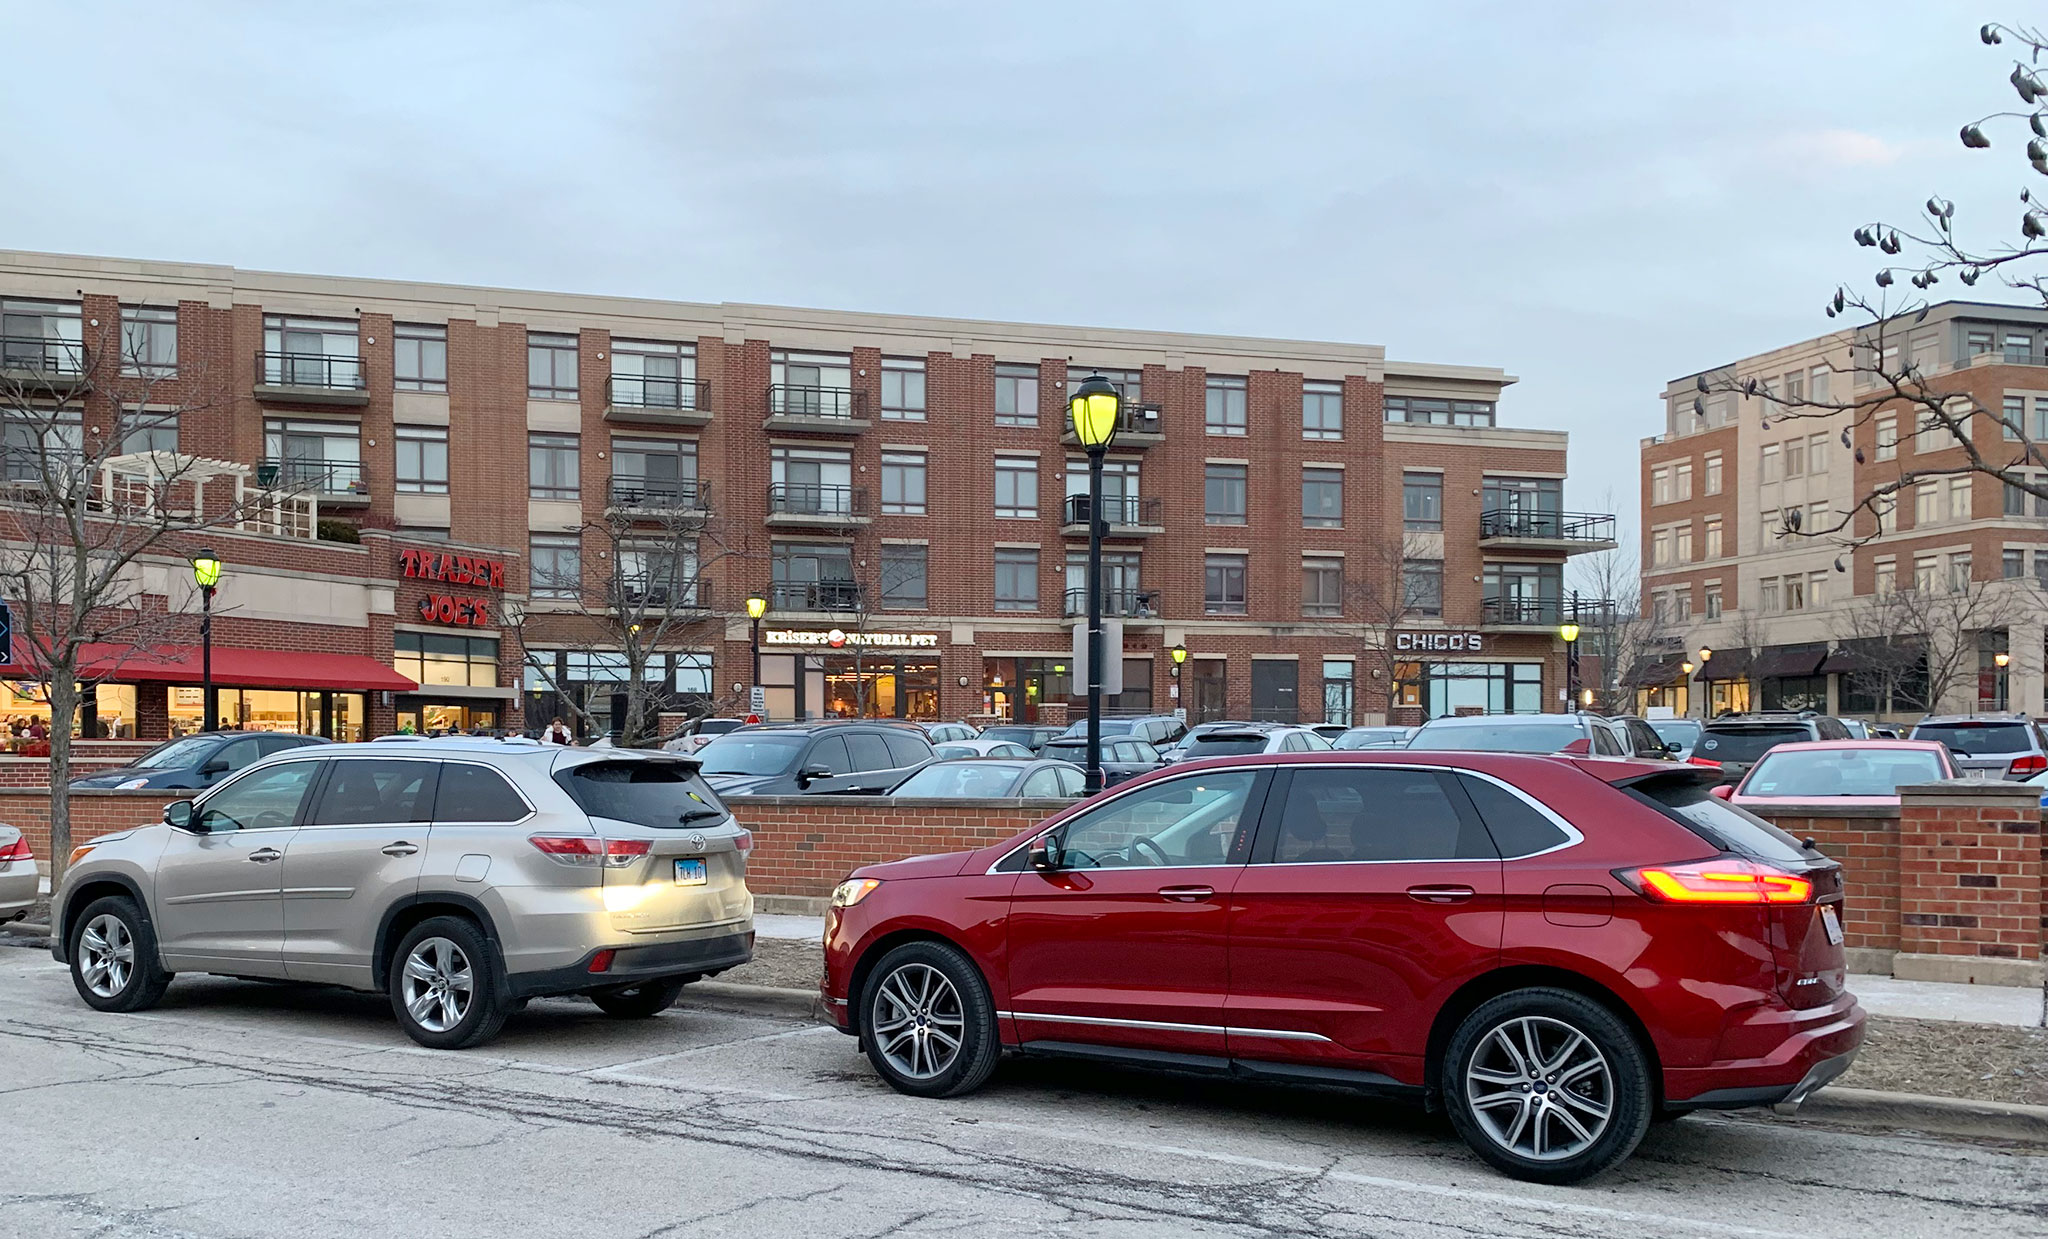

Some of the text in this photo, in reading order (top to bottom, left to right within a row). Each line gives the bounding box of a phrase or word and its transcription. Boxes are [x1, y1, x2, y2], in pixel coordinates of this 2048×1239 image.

[400, 549, 505, 588] TRADER
[420, 593, 489, 625] JOE'S
[910, 634, 938, 646] PET
[1396, 632, 1482, 651] CHICO'S
